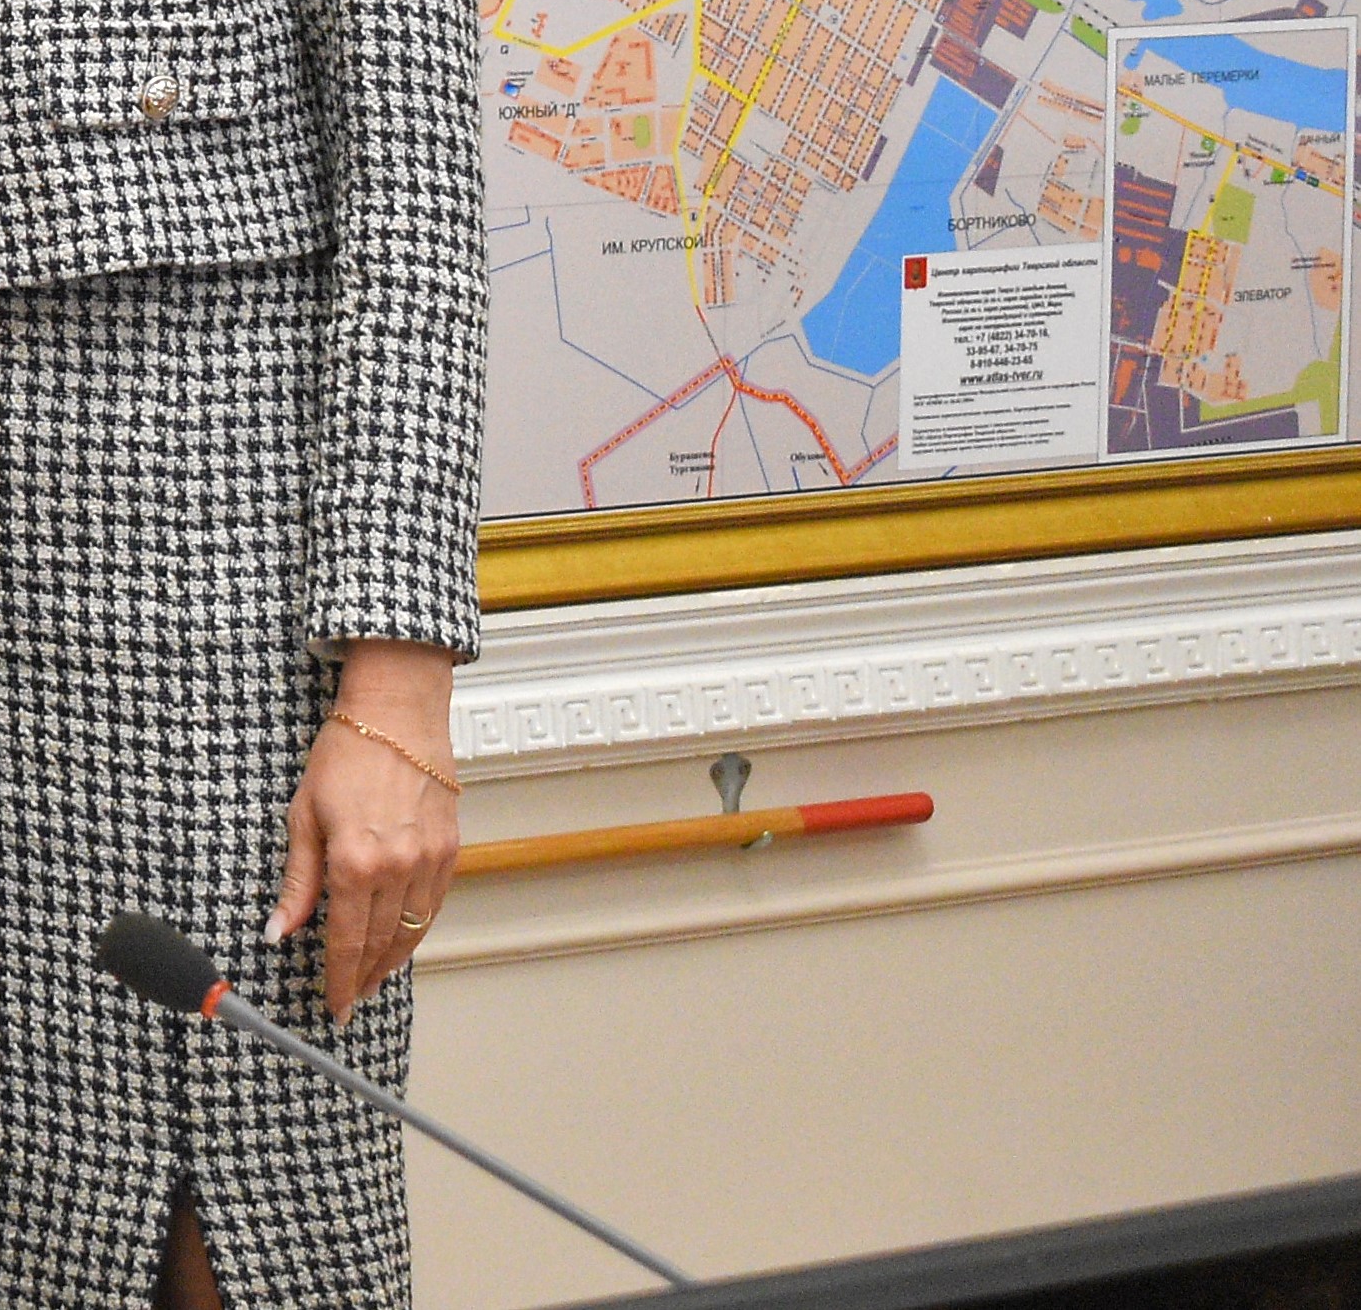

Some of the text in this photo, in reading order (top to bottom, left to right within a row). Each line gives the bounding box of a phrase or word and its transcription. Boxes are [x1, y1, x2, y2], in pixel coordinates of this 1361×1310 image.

[1144, 70, 1260, 87] МАЛЫЕ ПЕРЕМЕРКИ
[498, 101, 558, 120] ЮЖНЫЙ
[947, 213, 1037, 232] БОРТНИКОВО
[601, 233, 705, 256] ИМ. КРУПСКОЙ
[1234, 286, 1292, 303] ЭЛЕВАТОР
